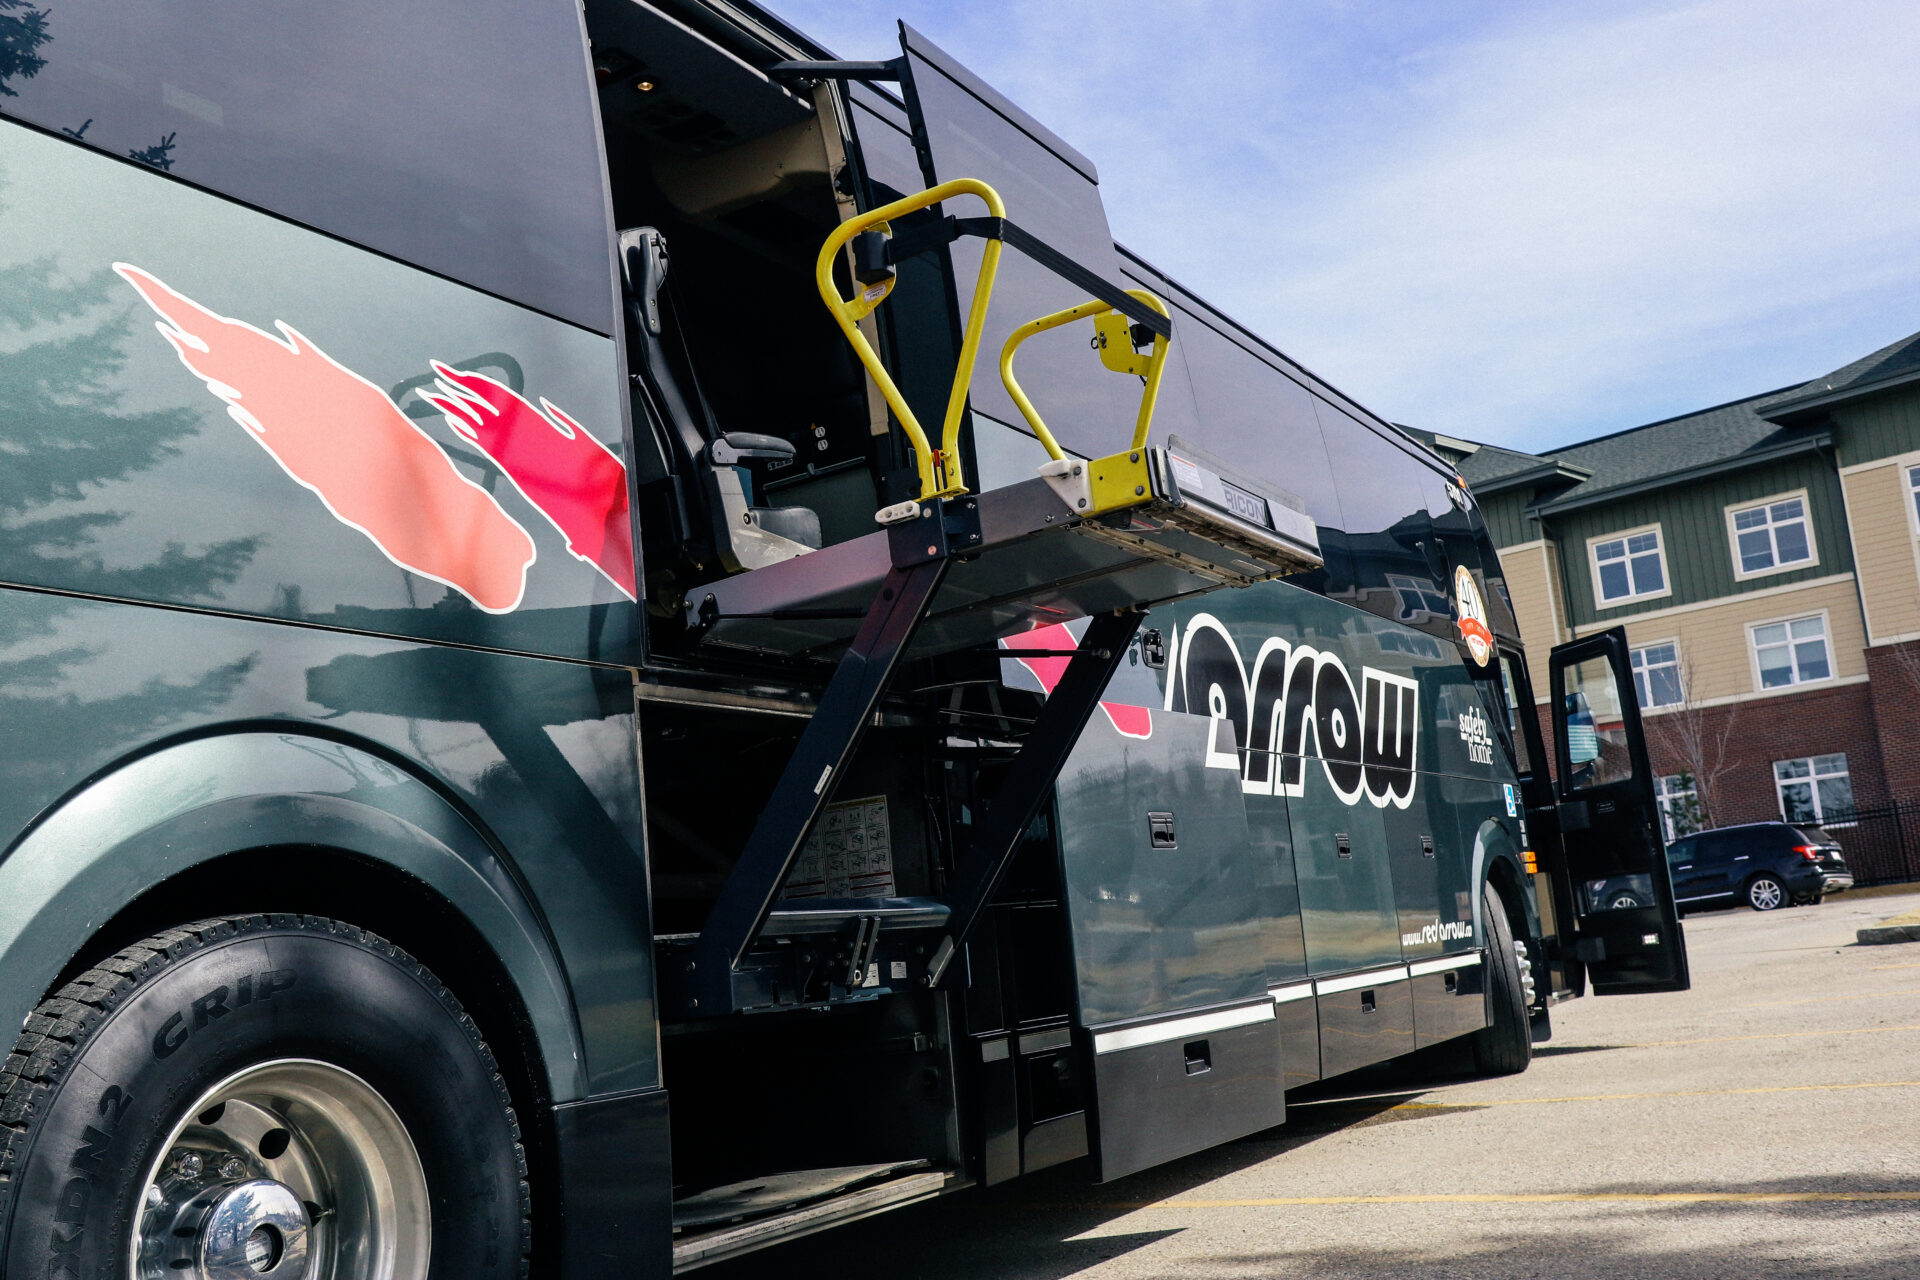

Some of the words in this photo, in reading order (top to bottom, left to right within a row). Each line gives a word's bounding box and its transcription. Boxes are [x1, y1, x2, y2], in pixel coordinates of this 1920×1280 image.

[1223, 488, 1266, 525] RICON
[1461, 576, 1480, 620] 40
[1458, 704, 1488, 746] safely
[1468, 737, 1494, 766] home
[151, 967, 299, 1062] GRIP
